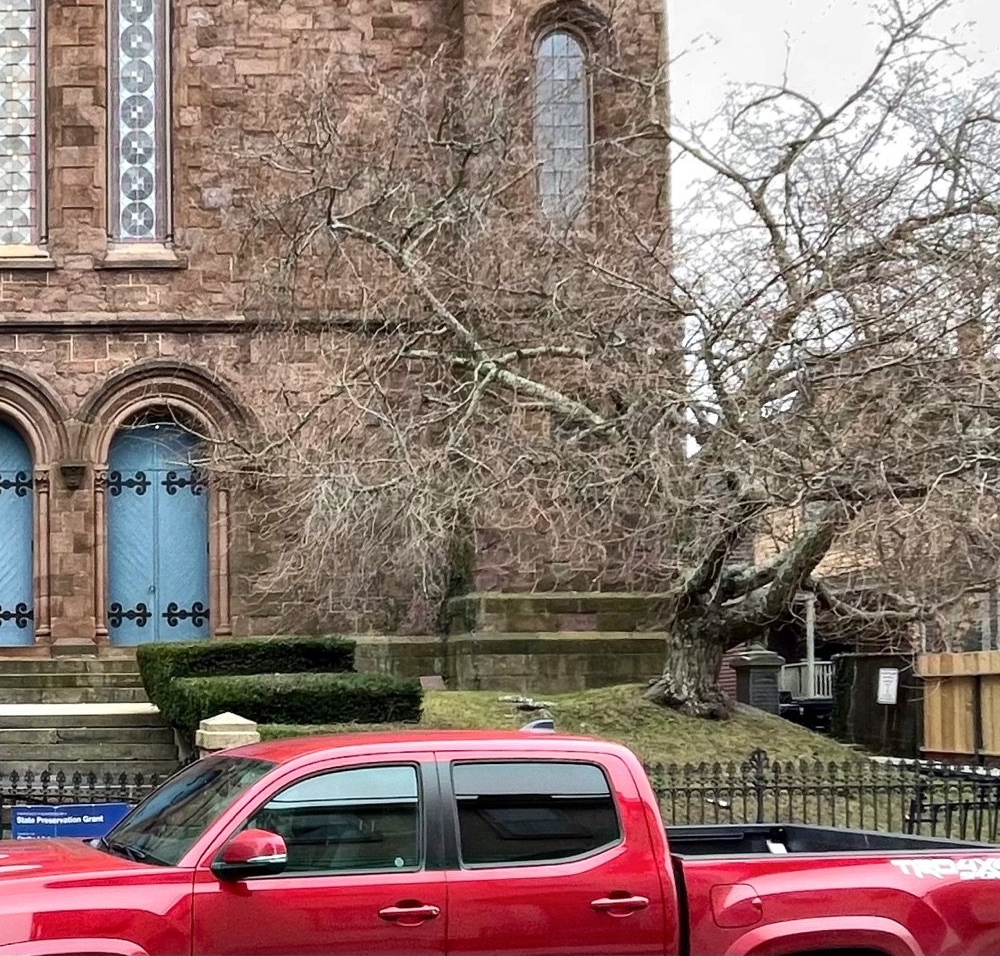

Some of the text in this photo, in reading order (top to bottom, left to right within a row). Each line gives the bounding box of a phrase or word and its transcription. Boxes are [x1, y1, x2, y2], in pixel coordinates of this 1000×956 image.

[16, 815, 104, 824] State Preservation Grant
